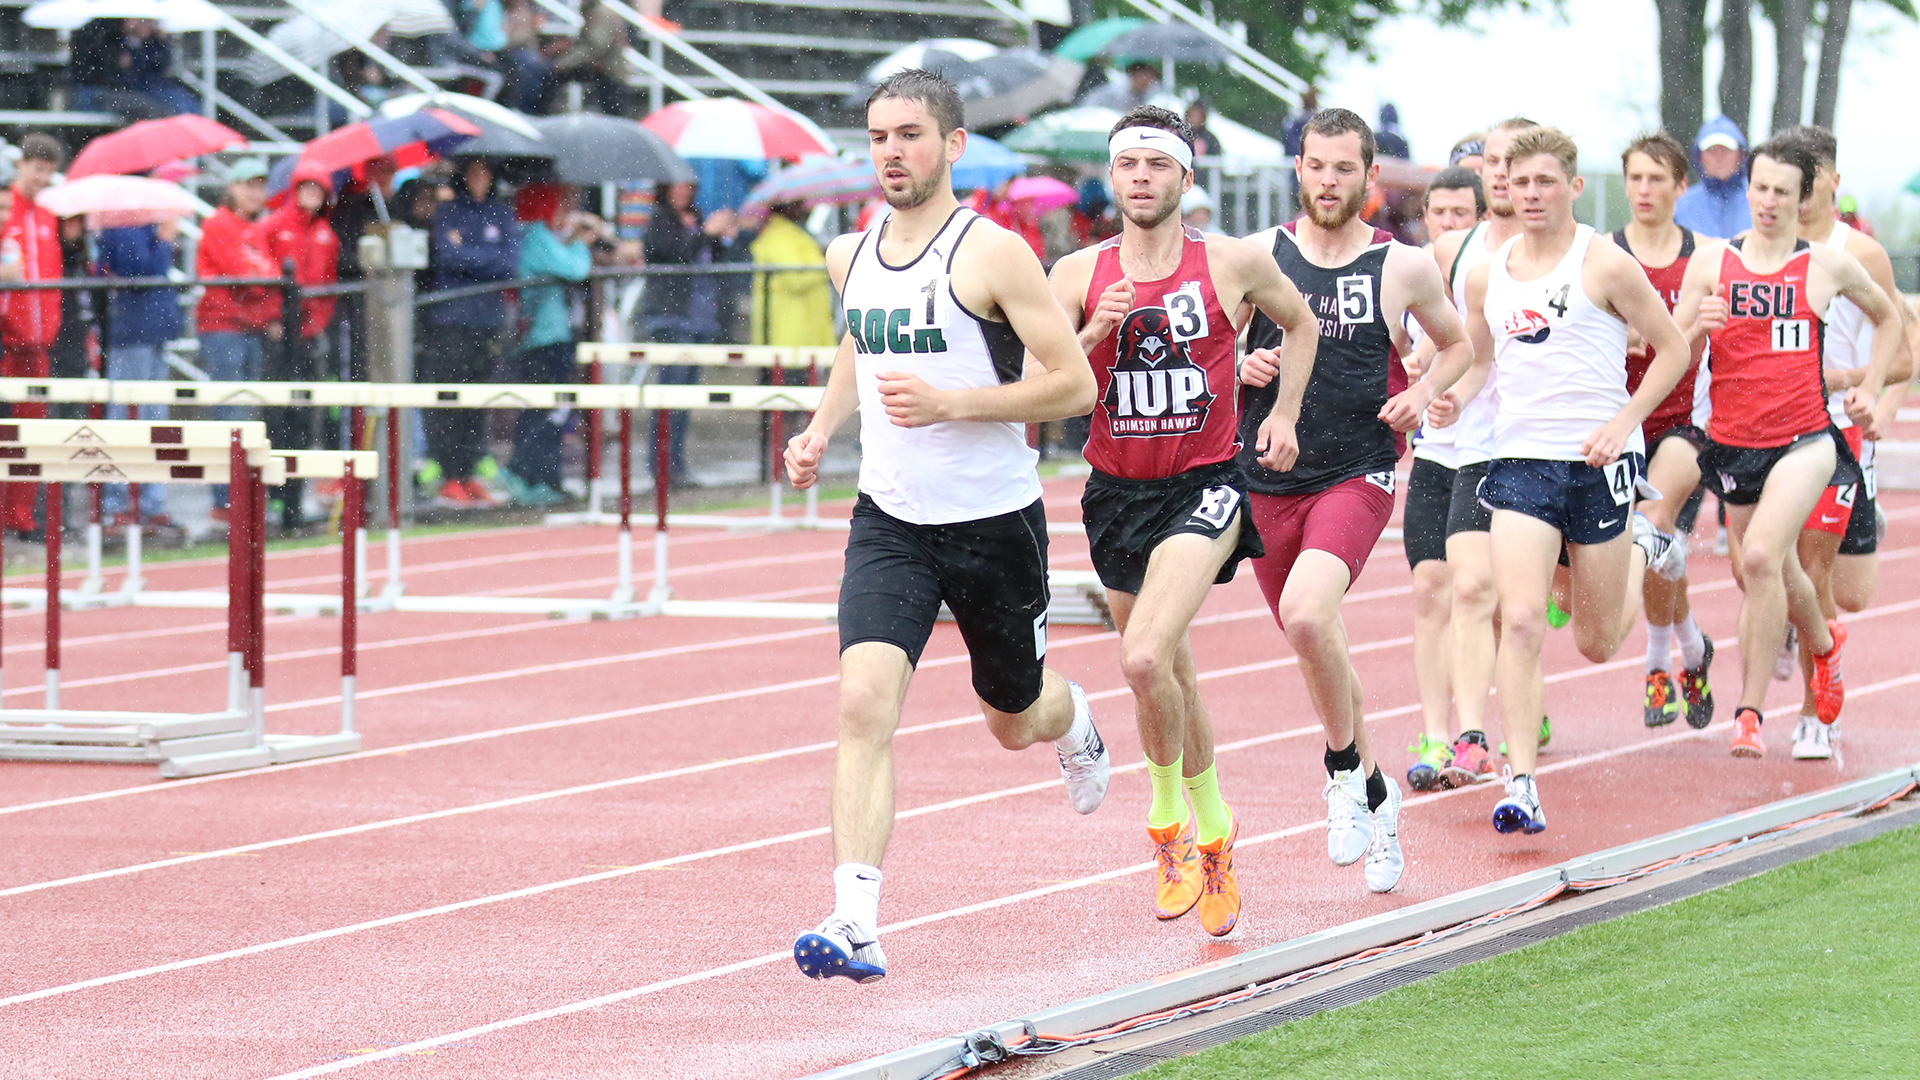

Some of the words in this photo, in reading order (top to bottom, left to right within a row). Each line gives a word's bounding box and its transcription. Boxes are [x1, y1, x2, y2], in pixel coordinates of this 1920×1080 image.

[921, 279, 937, 325] 1
[1171, 294, 1201, 337] 3
[1343, 279, 1367, 319] 5
[1548, 284, 1571, 318] 4
[1730, 280, 1795, 319] ESU
[1775, 323, 1800, 348] 11
[1113, 368, 1205, 417] IUP
[1113, 420, 1158, 432] CRIMSON
[1161, 416, 1198, 430] HAWKS
[1613, 464, 1629, 498] 4
[1200, 486, 1231, 521] 3
